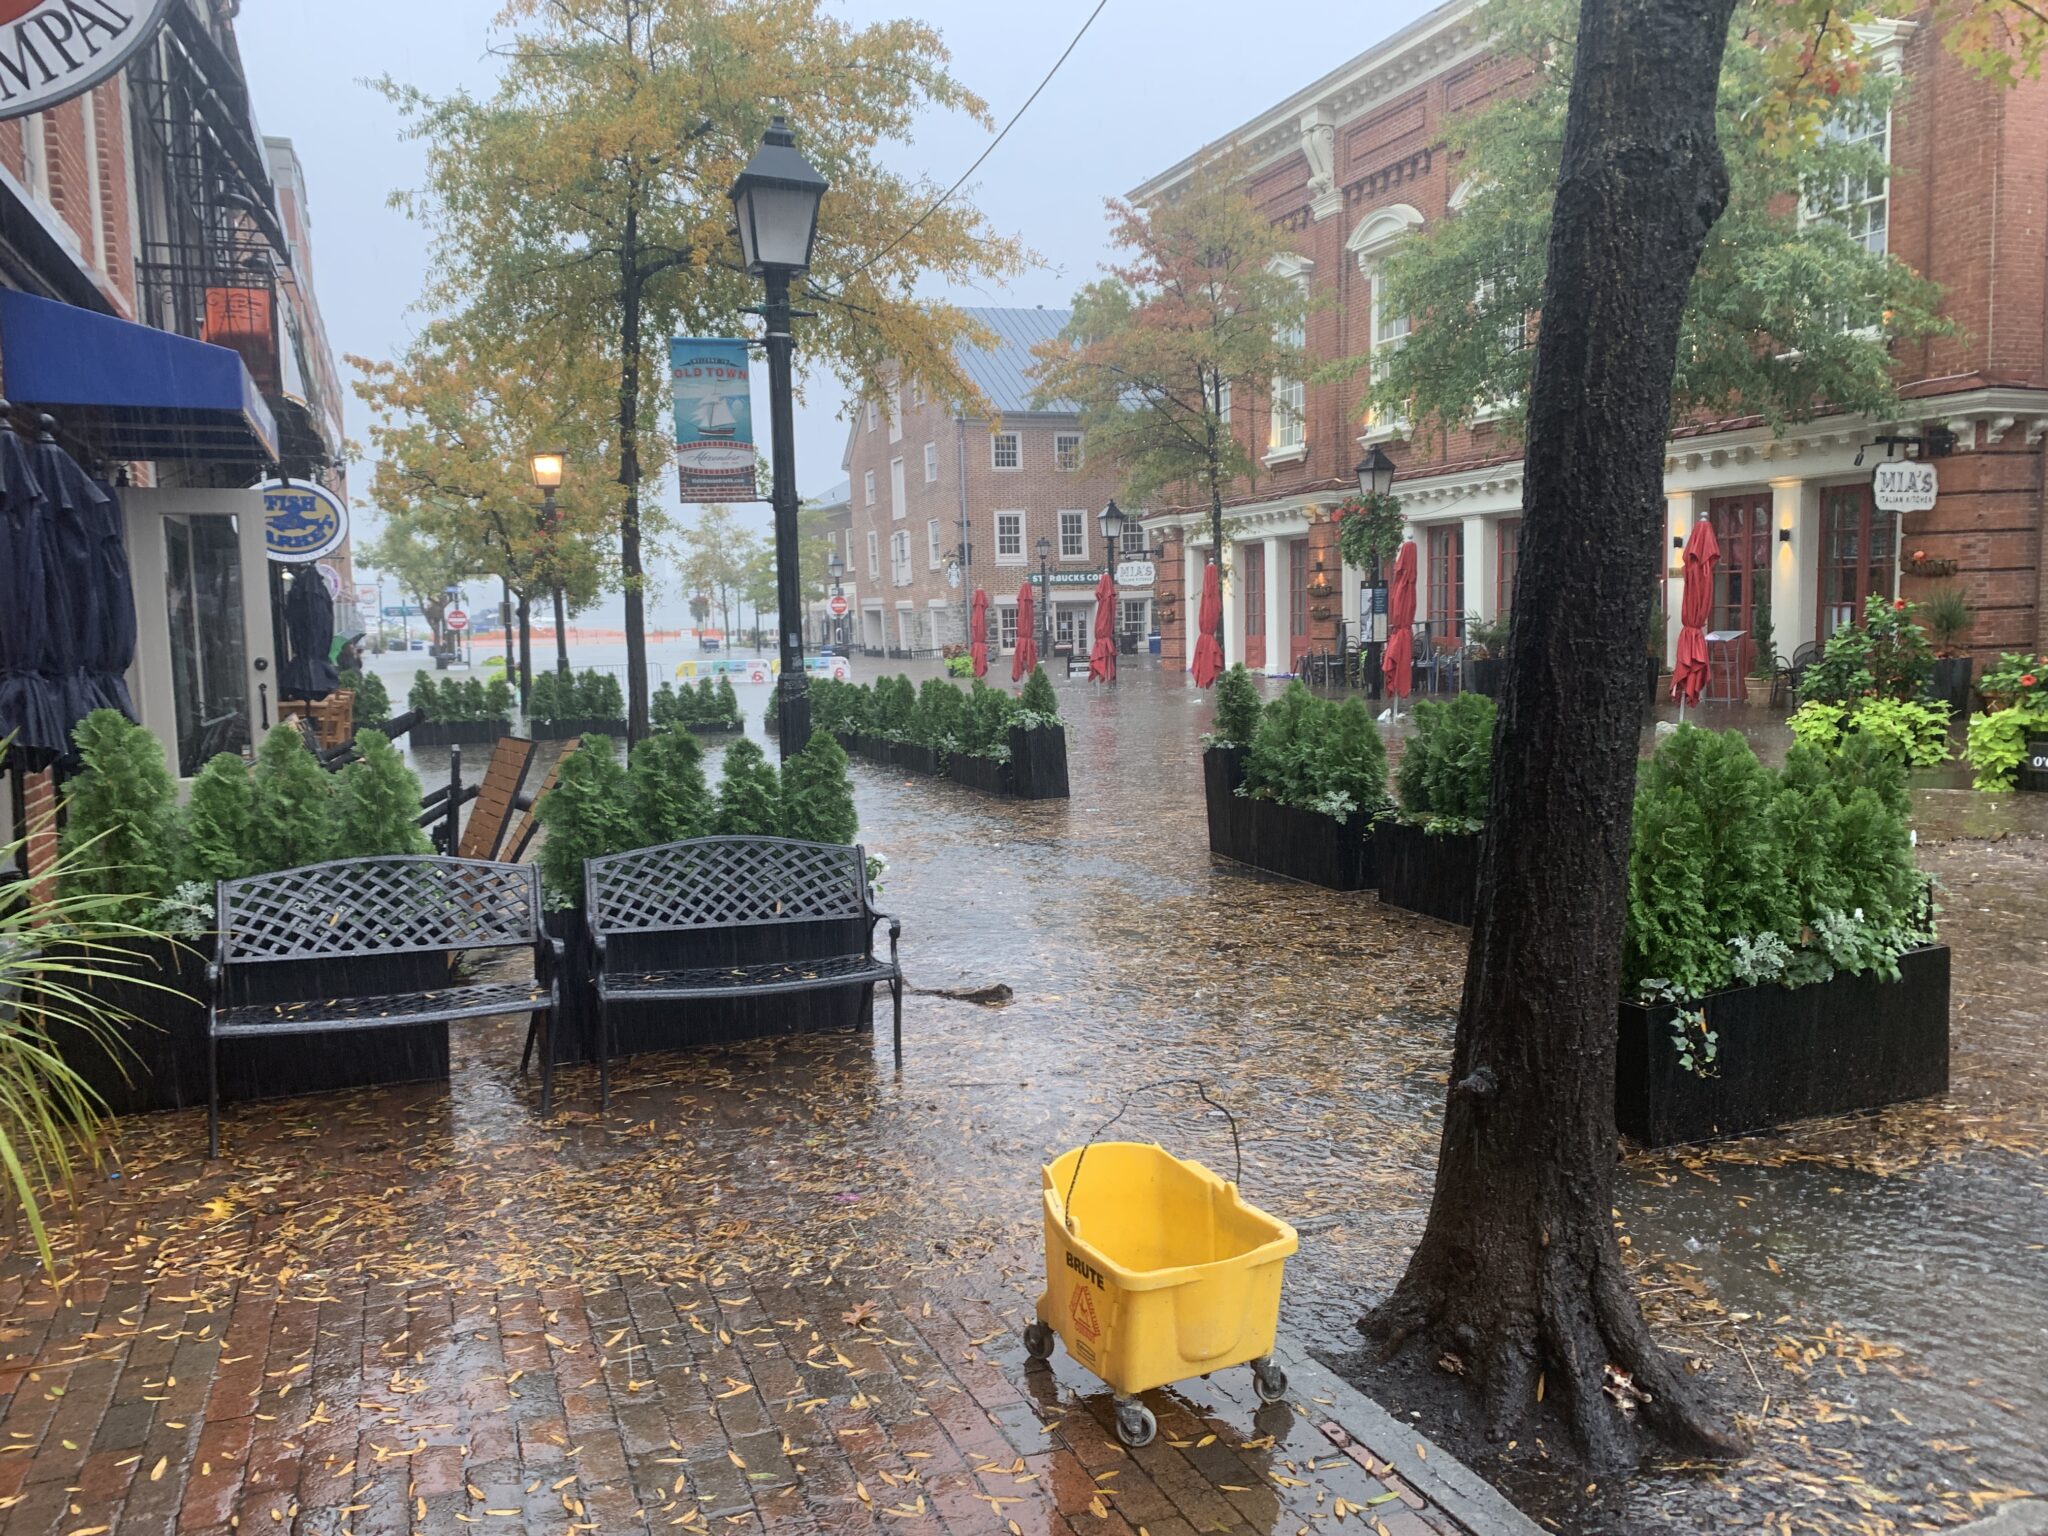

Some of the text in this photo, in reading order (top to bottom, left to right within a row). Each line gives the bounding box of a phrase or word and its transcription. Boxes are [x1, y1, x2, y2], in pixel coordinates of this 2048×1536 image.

[674, 367, 748, 379] OLD TOWN
[1880, 470, 1933, 493] MIA'S
[1120, 566, 1152, 577] MIA'S
[1032, 574, 1085, 582] STRBUCKS
[1066, 1251, 1105, 1291] BRUTE
